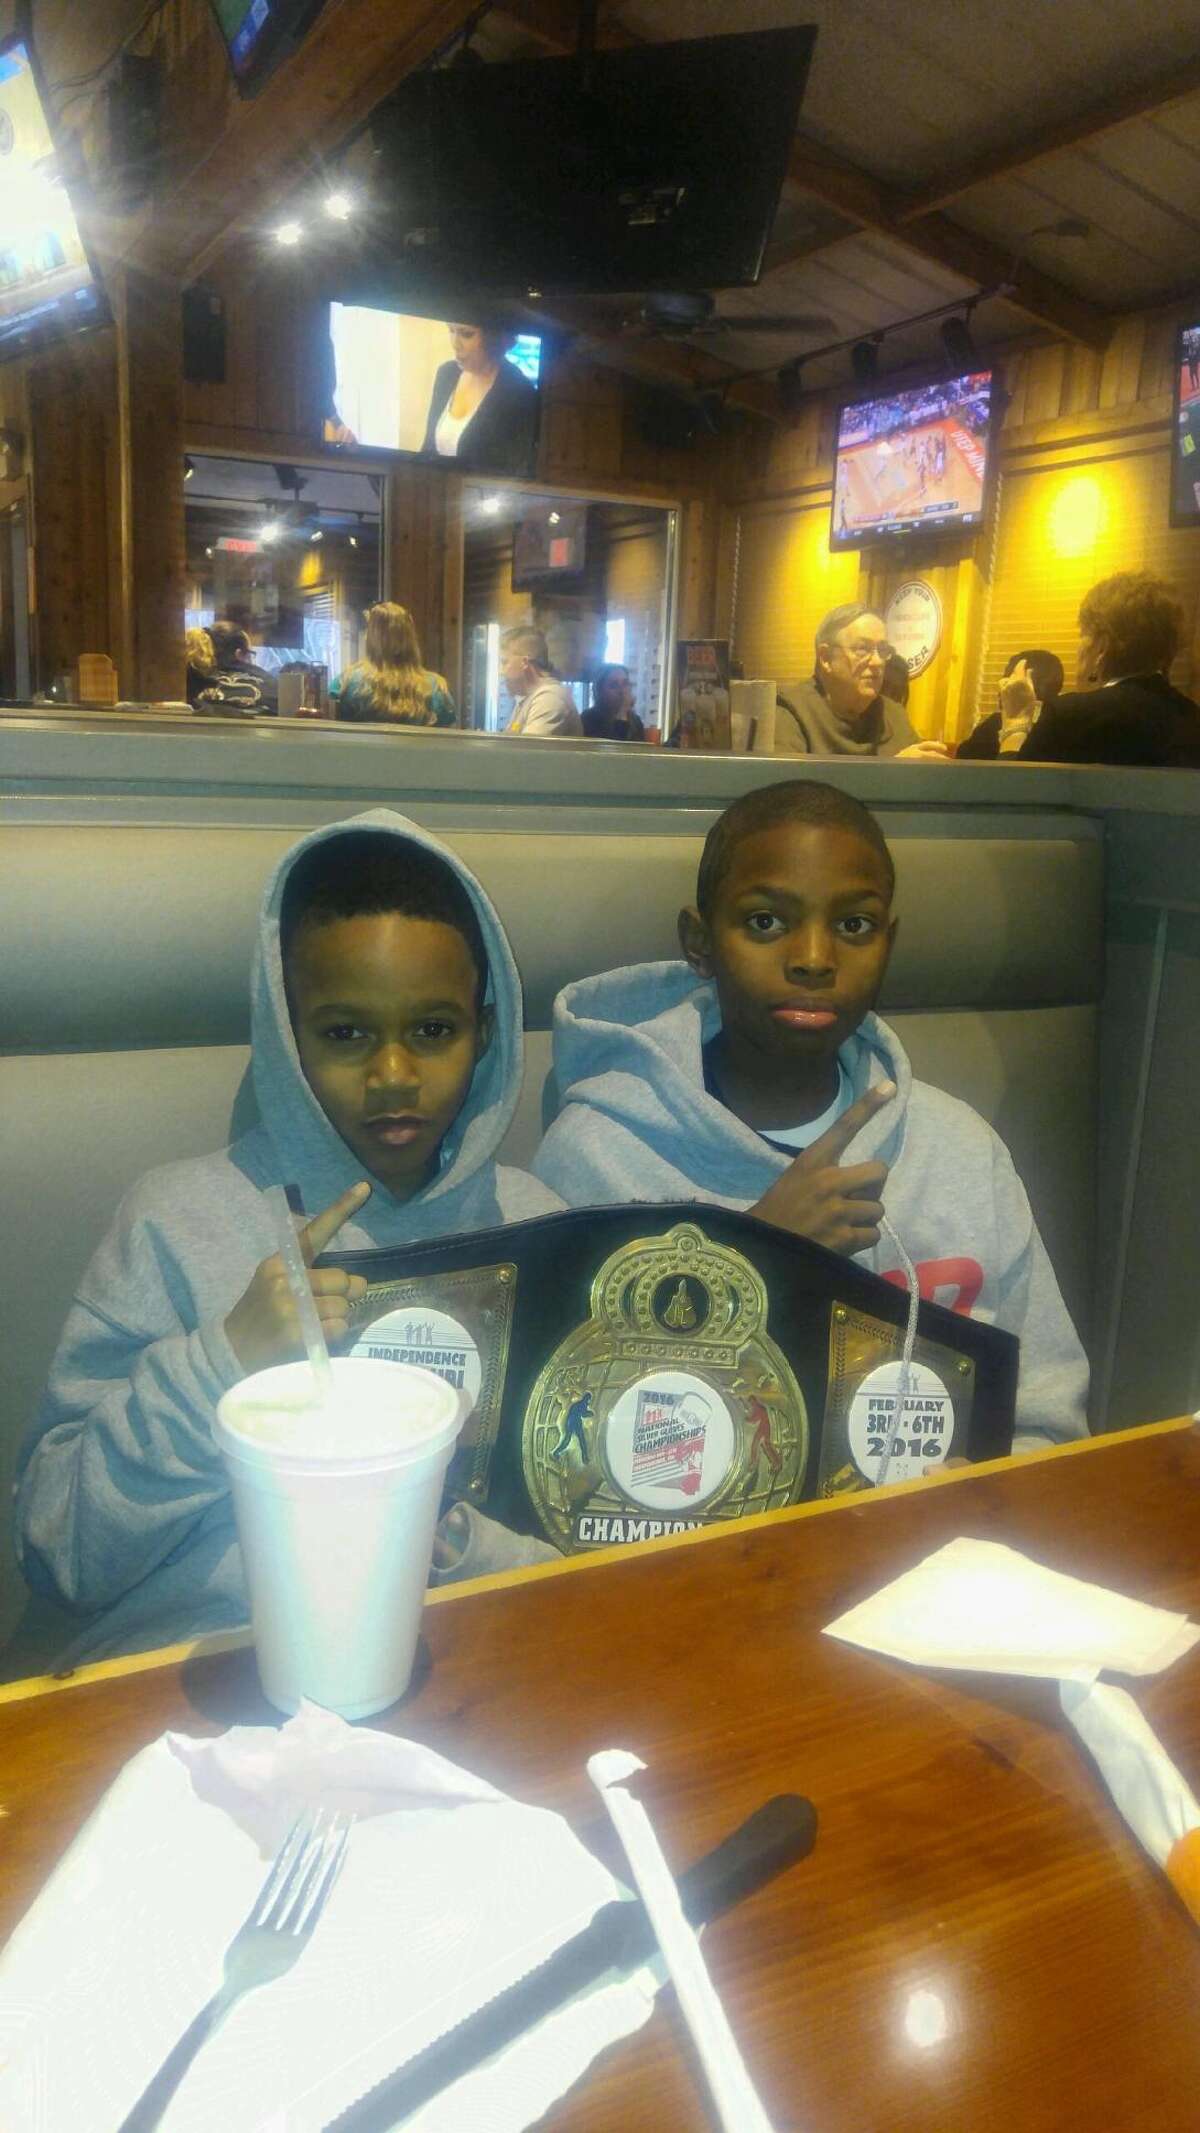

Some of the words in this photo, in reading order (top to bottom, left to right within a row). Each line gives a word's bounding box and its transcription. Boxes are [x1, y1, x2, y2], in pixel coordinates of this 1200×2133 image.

[368, 1347, 466, 1367] INDEPENDENCE
[869, 1399, 945, 1412] FEBUARY
[867, 1414, 896, 1433] 3R
[912, 1415, 945, 1434] 6TH
[634, 1424, 706, 1454] CHAMPIONSHIPS
[867, 1437, 942, 1458] 2016
